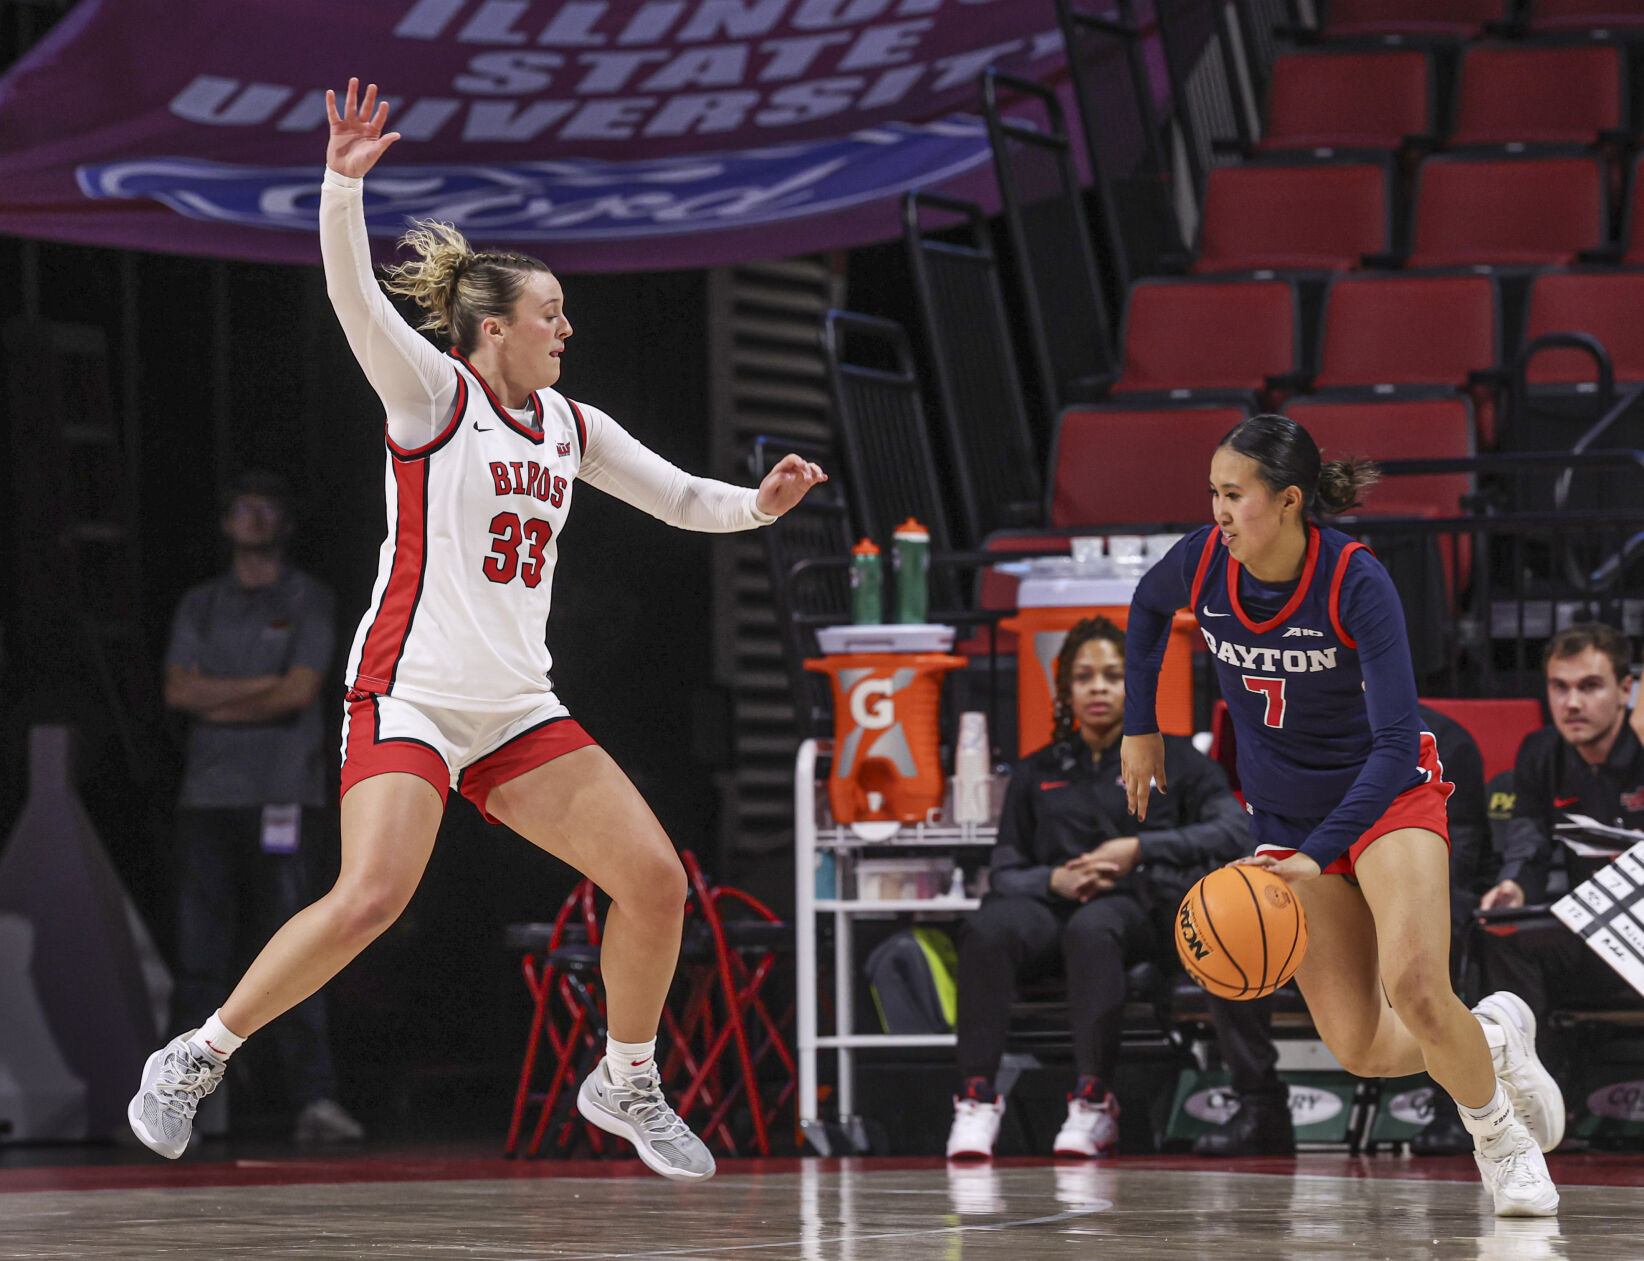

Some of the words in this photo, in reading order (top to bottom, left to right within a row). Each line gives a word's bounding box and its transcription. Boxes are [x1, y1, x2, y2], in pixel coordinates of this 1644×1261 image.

[394, 0, 999, 45] ILLINO
[453, 17, 935, 96] STATE
[489, 461, 567, 508] BIRDS
[482, 511, 553, 588] 33
[1200, 627, 1337, 672] DAYTON
[851, 678, 895, 729] G
[1241, 674, 1286, 729] 7
[1180, 899, 1210, 961] NCAA
